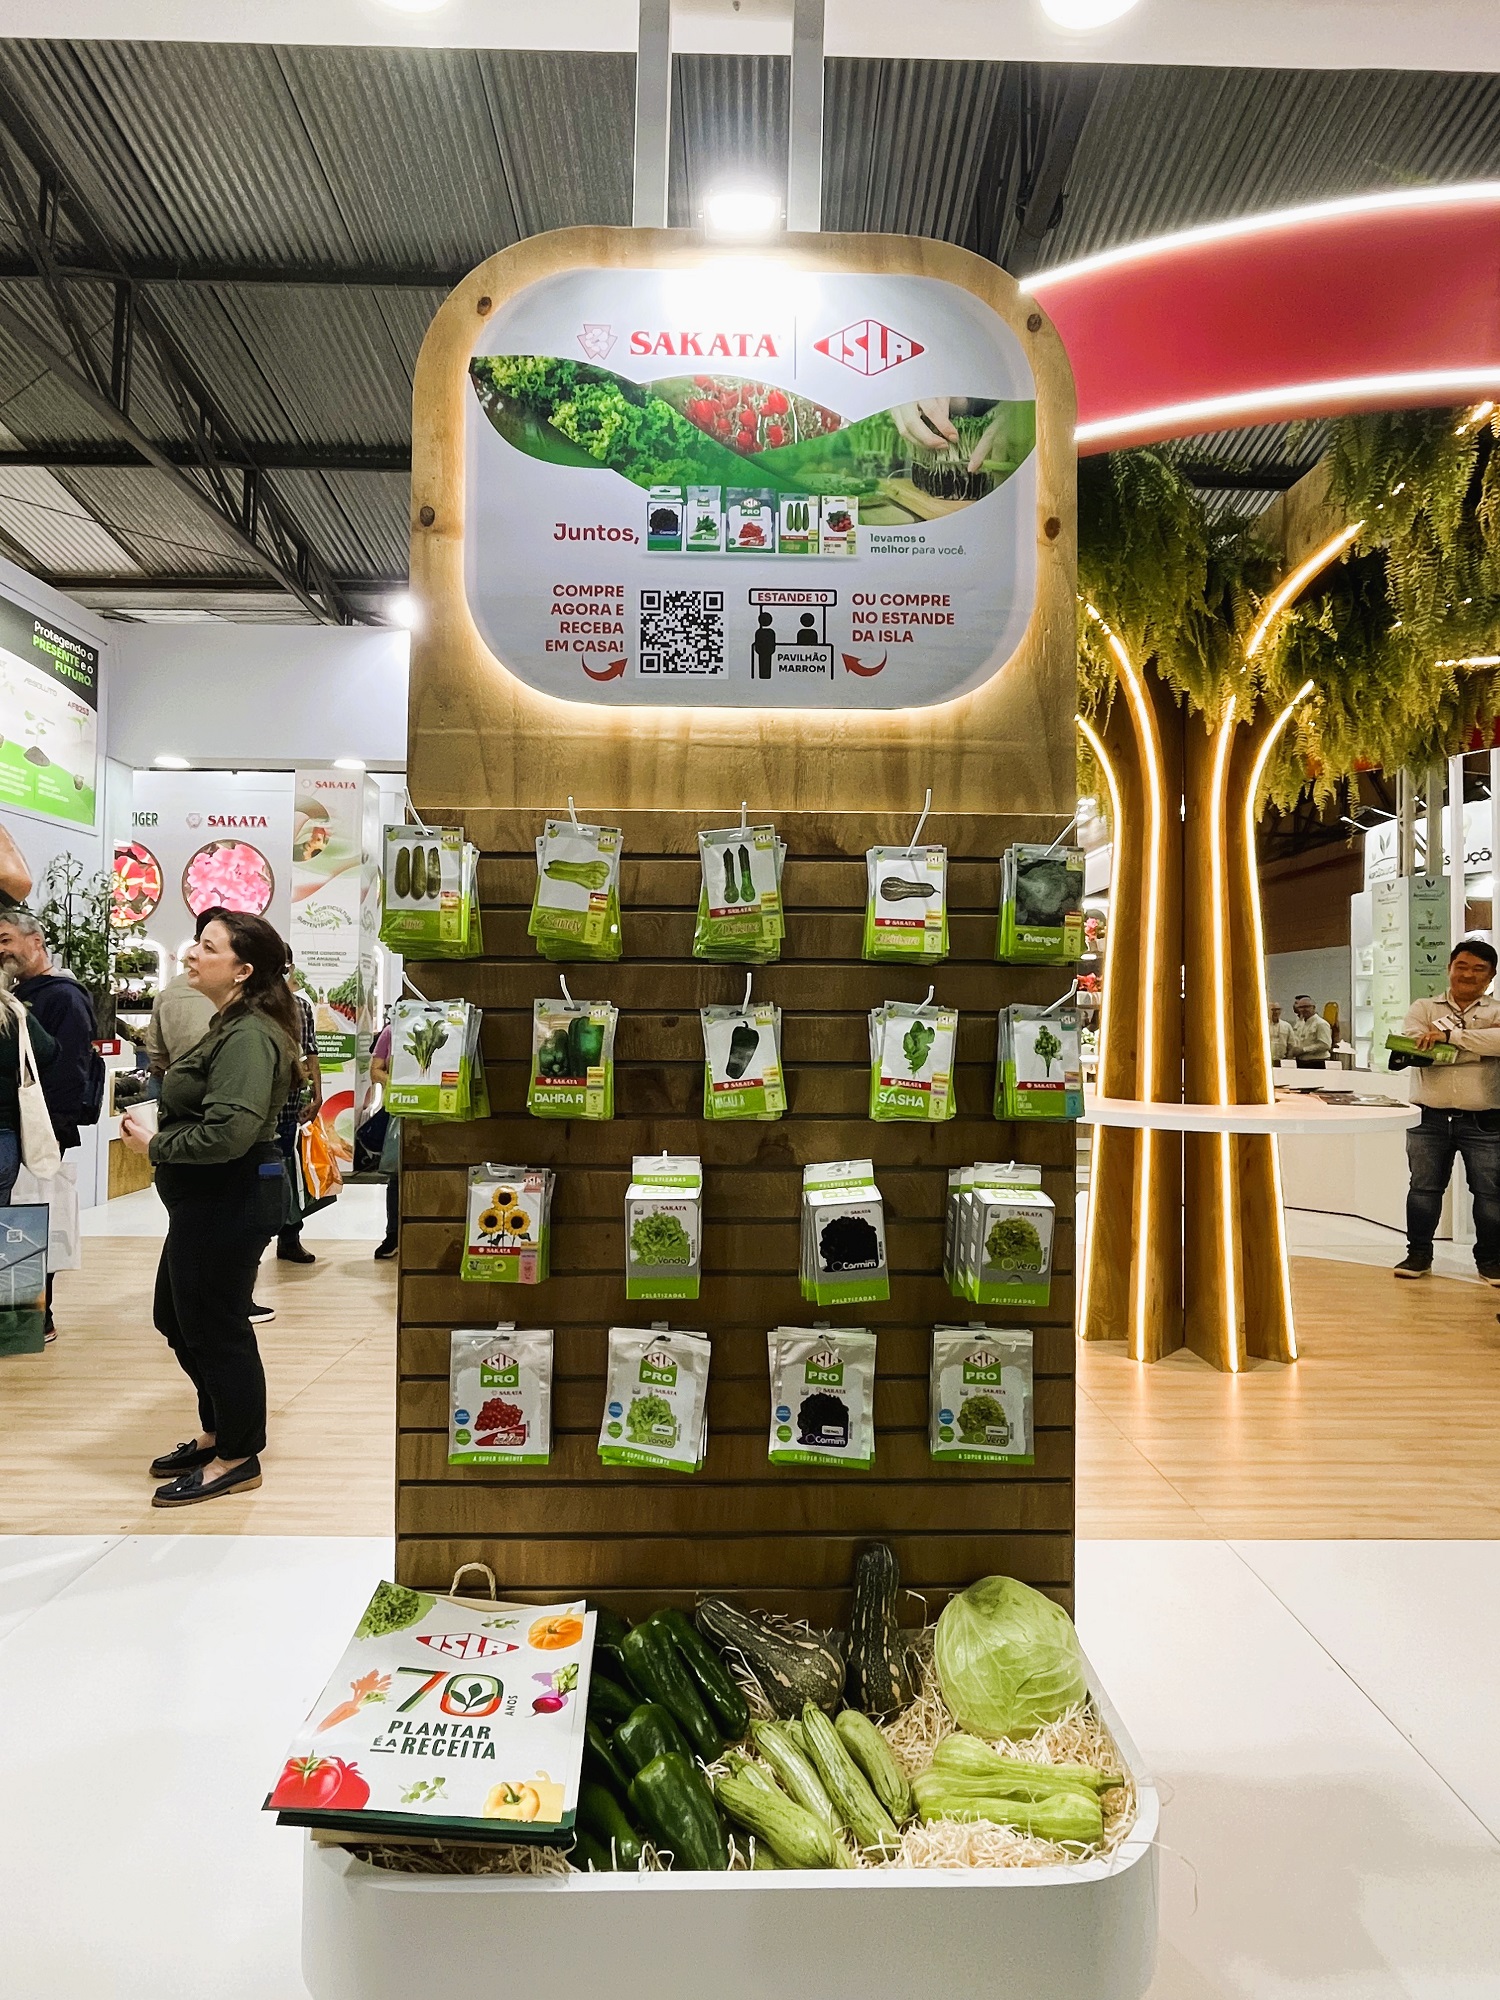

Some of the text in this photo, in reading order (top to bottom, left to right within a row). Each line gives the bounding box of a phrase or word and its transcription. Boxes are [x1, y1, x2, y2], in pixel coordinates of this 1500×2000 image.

[630, 320, 914, 376] SAKATA ISLA
[553, 523, 640, 545] Juntos,
[870, 533, 926, 543] levamos o
[870, 544, 967, 556] melhor para você.
[552, 584, 625, 598] COMPRE
[757, 592, 828, 603] ESTANDE 10
[851, 593, 951, 607] OU COMPRE
[550, 603, 625, 616] AGORA E
[851, 611, 955, 625] NO ESTANDE
[560, 621, 625, 634] RECEBA
[34, 620, 94, 661] Protegendo o
[851, 629, 915, 643] DA ISLA
[545, 639, 624, 653] EM CASA!
[32, 634, 94, 674] PRESENTE e o
[777, 651, 828, 662] PAVILHÃO
[778, 664, 826, 674] MARROM
[315, 780, 357, 790] SAKATA
[207, 815, 269, 829] SAKATA
[1023, 932, 1062, 947] Avenger
[389, 1092, 419, 1104] Pina
[534, 1093, 584, 1104] DAHRA R
[879, 1092, 925, 1108] SASHA
[1016, 1210, 1043, 1218] SAKATA
[657, 1256, 687, 1265] Vanda
[842, 1261, 877, 1270] Carmim
[1015, 1262, 1038, 1271] Vera
[831, 1295, 877, 1304] PELETIZADAS
[991, 1297, 1036, 1305] PELETIZADAS
[486, 1353, 515, 1372] ISLA
[647, 1352, 674, 1370] ISLA
[969, 1351, 996, 1369] ISLA
[483, 1374, 515, 1383] PRO
[642, 1370, 673, 1383] PRO
[808, 1371, 840, 1382] PRO
[965, 1371, 998, 1381] PRO
[647, 1435, 673, 1447] Vanda
[814, 1435, 847, 1445] Carmim
[986, 1435, 1006, 1445] Vera
[427, 1632, 510, 1660] ISLA
[396, 1666, 505, 1718] 70
[504, 1695, 518, 1717] ANOS
[387, 1720, 491, 1740] PLANTAR
[373, 1735, 496, 1760] É A RECEITA
